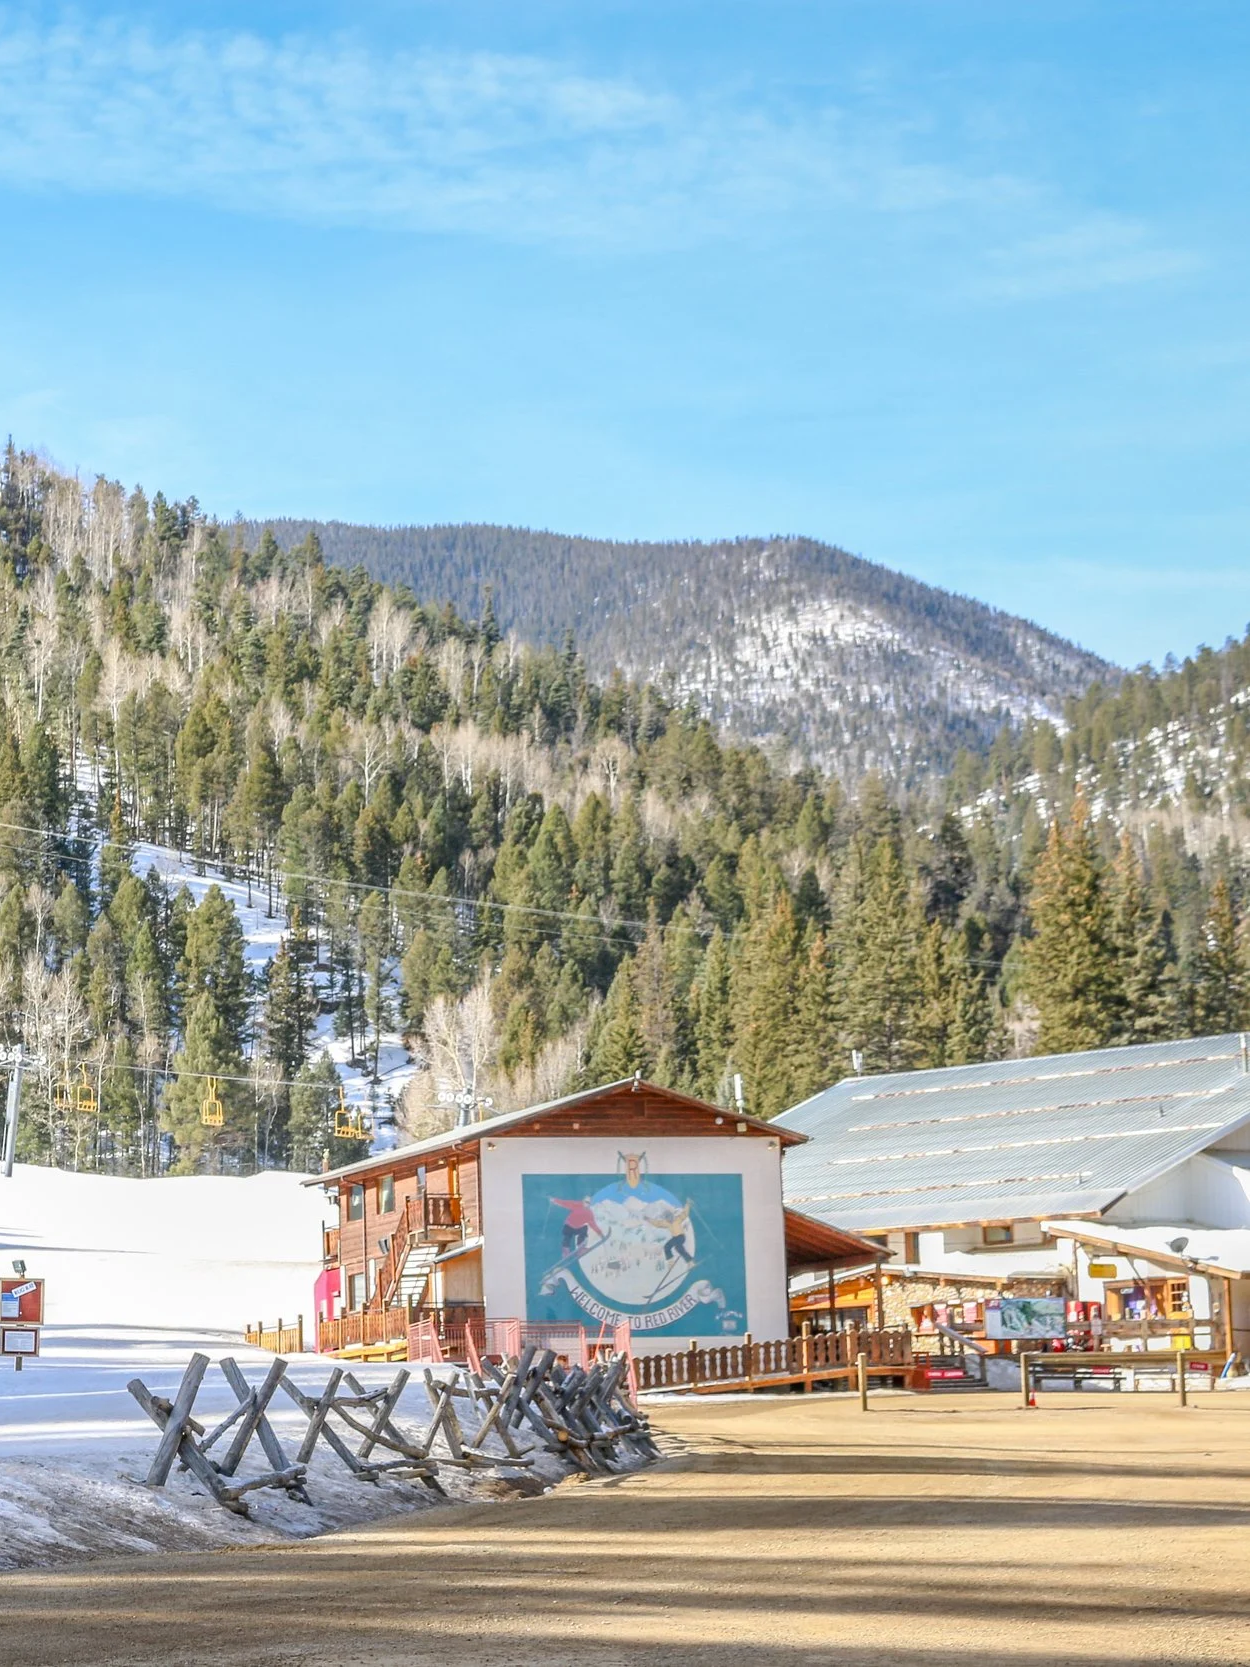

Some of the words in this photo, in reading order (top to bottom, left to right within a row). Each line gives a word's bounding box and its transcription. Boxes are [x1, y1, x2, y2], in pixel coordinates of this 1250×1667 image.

[571, 1286, 622, 1326] WELCOME
[628, 1316, 642, 1329] TO
[645, 1312, 668, 1328] RED
[669, 1294, 698, 1321] RIVER
